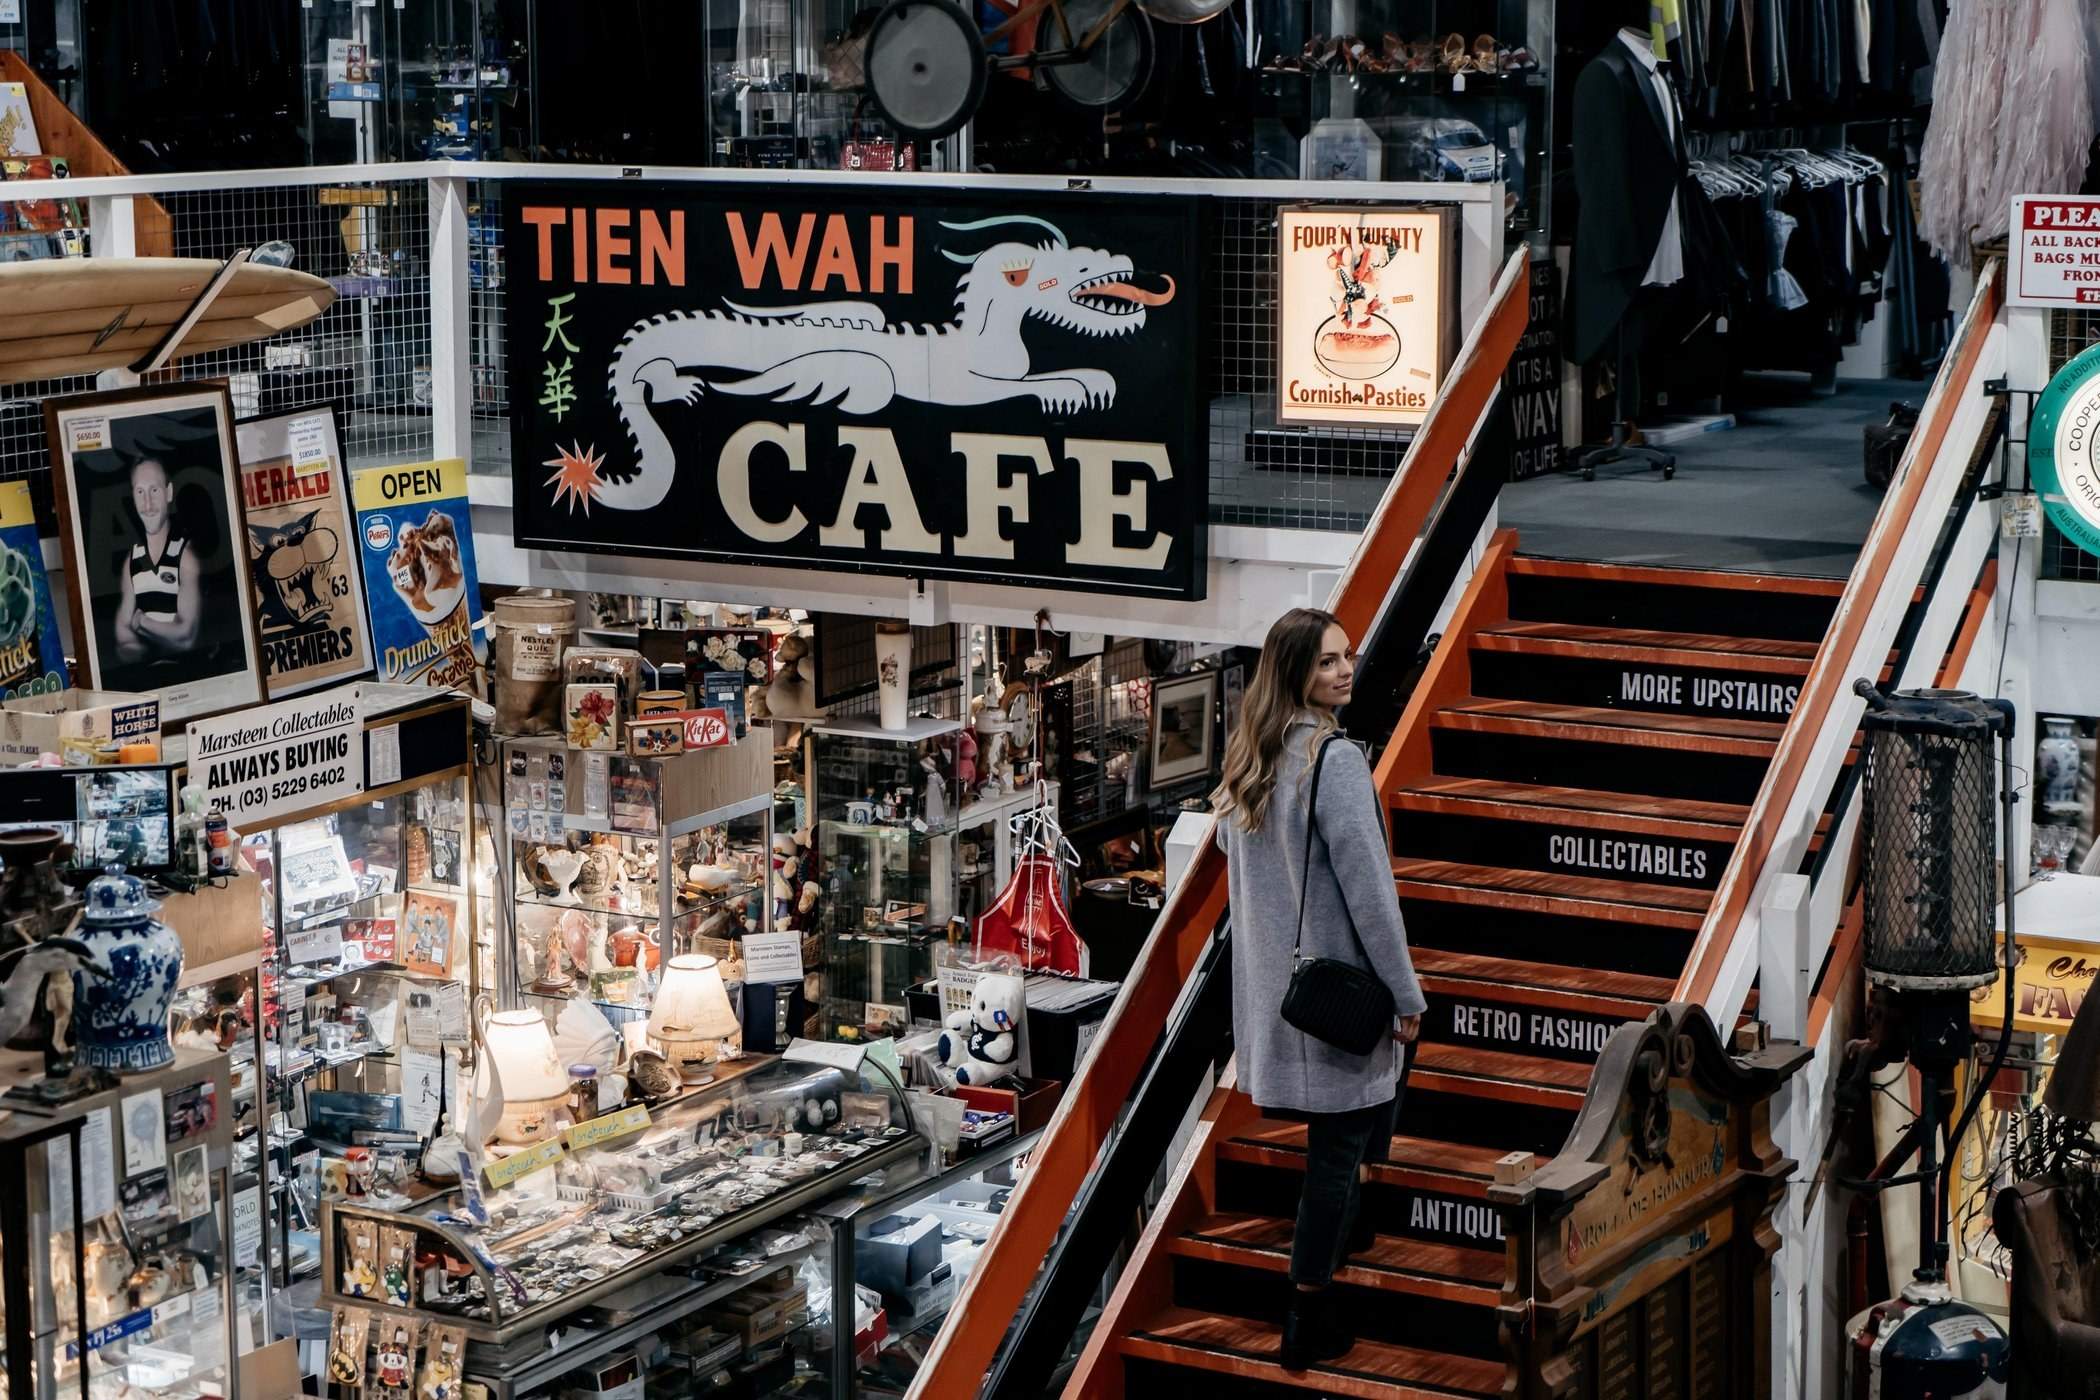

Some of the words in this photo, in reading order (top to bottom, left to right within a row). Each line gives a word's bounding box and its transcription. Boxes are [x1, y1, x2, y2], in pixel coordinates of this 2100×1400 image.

[522, 207, 685, 286] TIEN
[725, 212, 913, 293] WAH
[1356, 227, 1423, 253] TWENTY
[2031, 235, 2058, 247] ALL
[2034, 252, 2075, 263] BAGS
[1531, 296, 1545, 321] OT
[539, 292, 580, 424] 天華
[1517, 360, 1527, 385] IT
[1530, 358, 1541, 383] IS
[1545, 355, 1553, 380] A
[1290, 380, 1352, 404] Cornish
[1364, 384, 1426, 407] Pasties
[2059, 380, 2072, 393] NO
[1512, 388, 1560, 440] WAY
[1515, 448, 1530, 476] OF
[1534, 443, 1558, 472] LIFE
[242, 466, 330, 508] HERALD
[381, 468, 442, 499] OPEN
[717, 420, 1173, 570] CAFE
[262, 626, 353, 676] PREMIERS
[385, 617, 468, 680] Drumstick
[1622, 672, 1682, 704] MORE
[1693, 678, 1798, 714] UPSTAIRS
[114, 705, 156, 722] WHITE
[114, 718, 156, 735] HORSE
[198, 724, 268, 755] Marsteen
[272, 702, 355, 738] Collectables
[208, 750, 280, 790] ALWAYS
[286, 733, 348, 771] BUYING
[239, 786, 268, 812] (03)
[272, 777, 307, 800] 5229
[310, 766, 345, 790] 6402
[1549, 834, 1707, 879] COLLECTABLES
[1454, 1005, 1521, 1041] RETRO
[233, 1202, 256, 1218] ORLD
